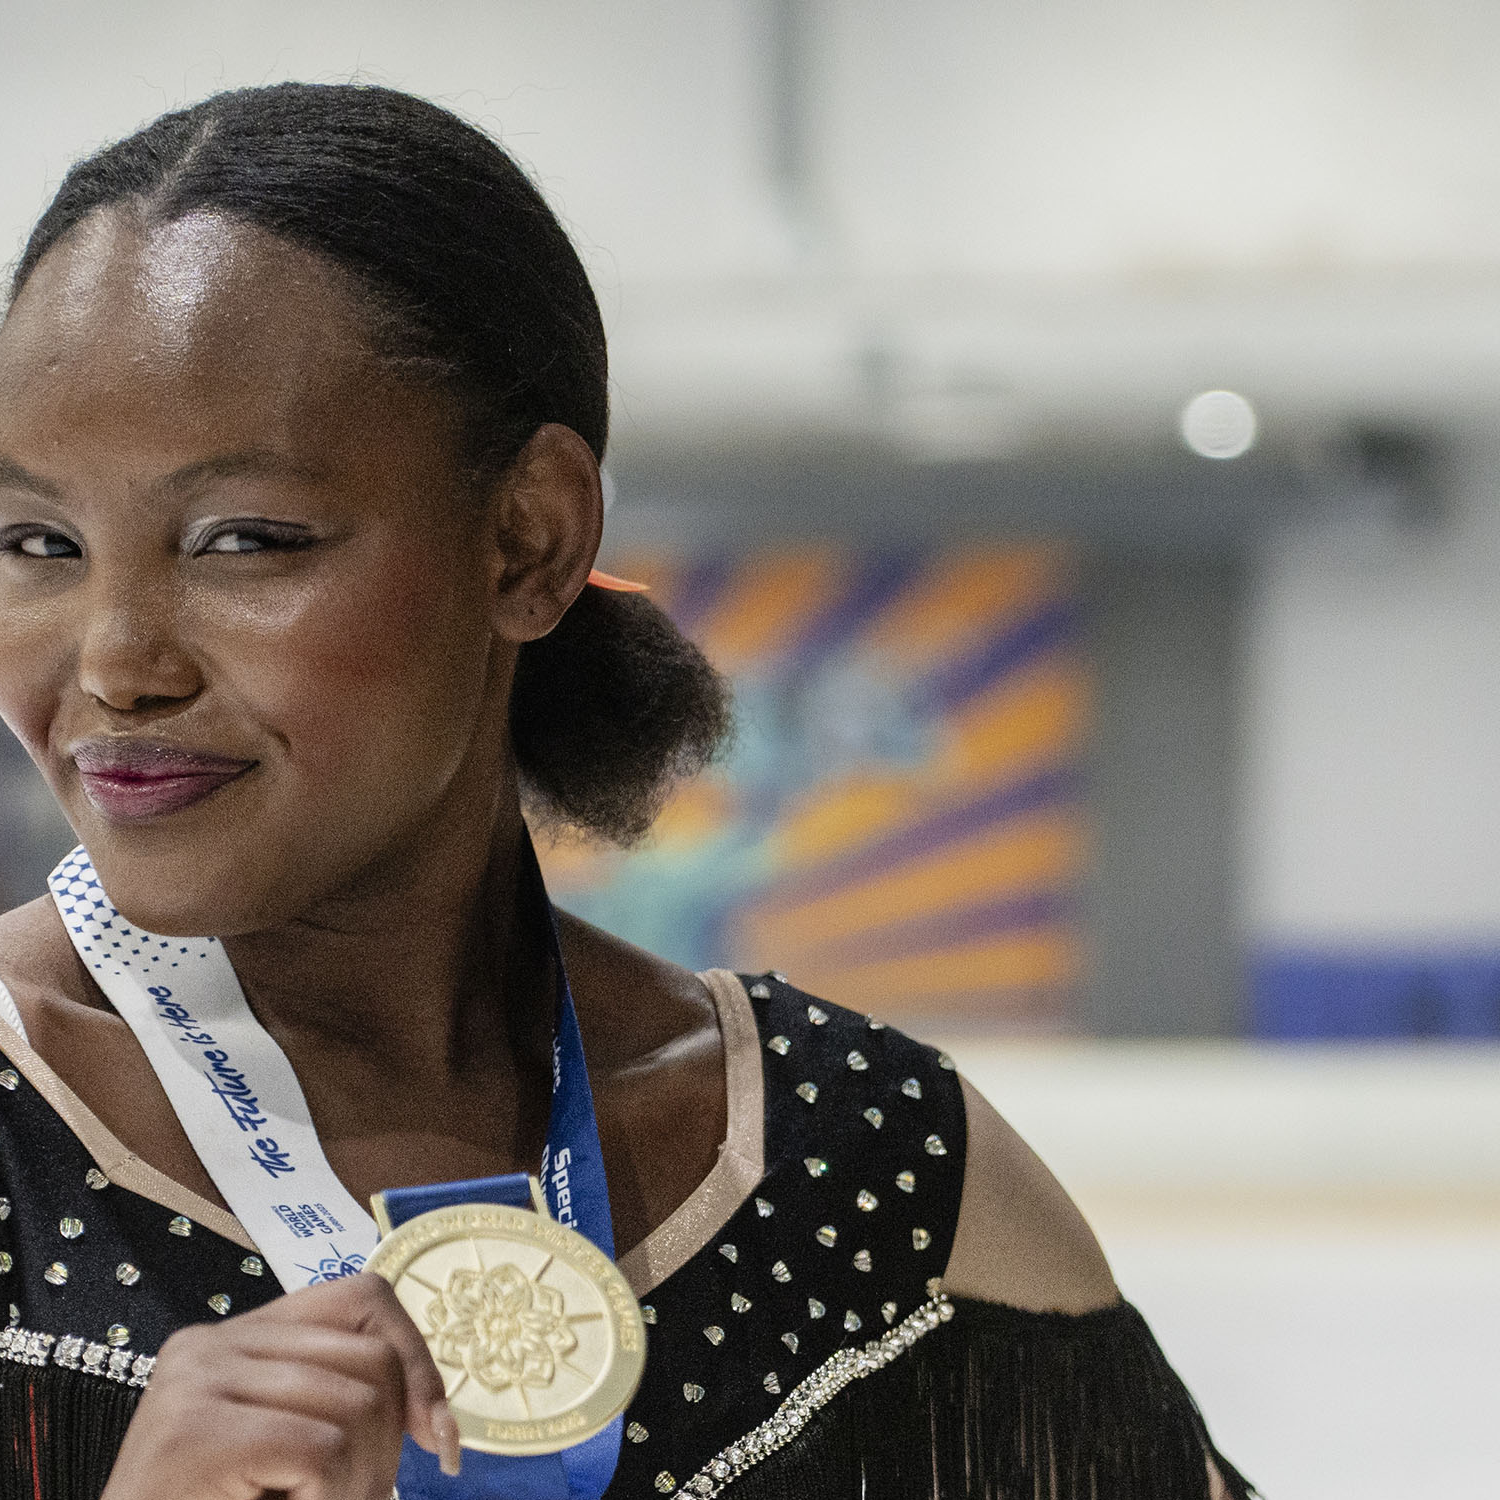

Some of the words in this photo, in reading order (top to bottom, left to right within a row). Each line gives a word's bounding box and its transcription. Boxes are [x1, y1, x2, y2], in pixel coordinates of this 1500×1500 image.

[147, 985, 200, 1030] Here
[179, 1032, 217, 1045] is
[203, 1049, 267, 1132] Future
[248, 1137, 295, 1179] The
[551, 1147, 578, 1230] Speci
[278, 1204, 314, 1238] WORLD
[297, 1204, 333, 1234] GAMES
